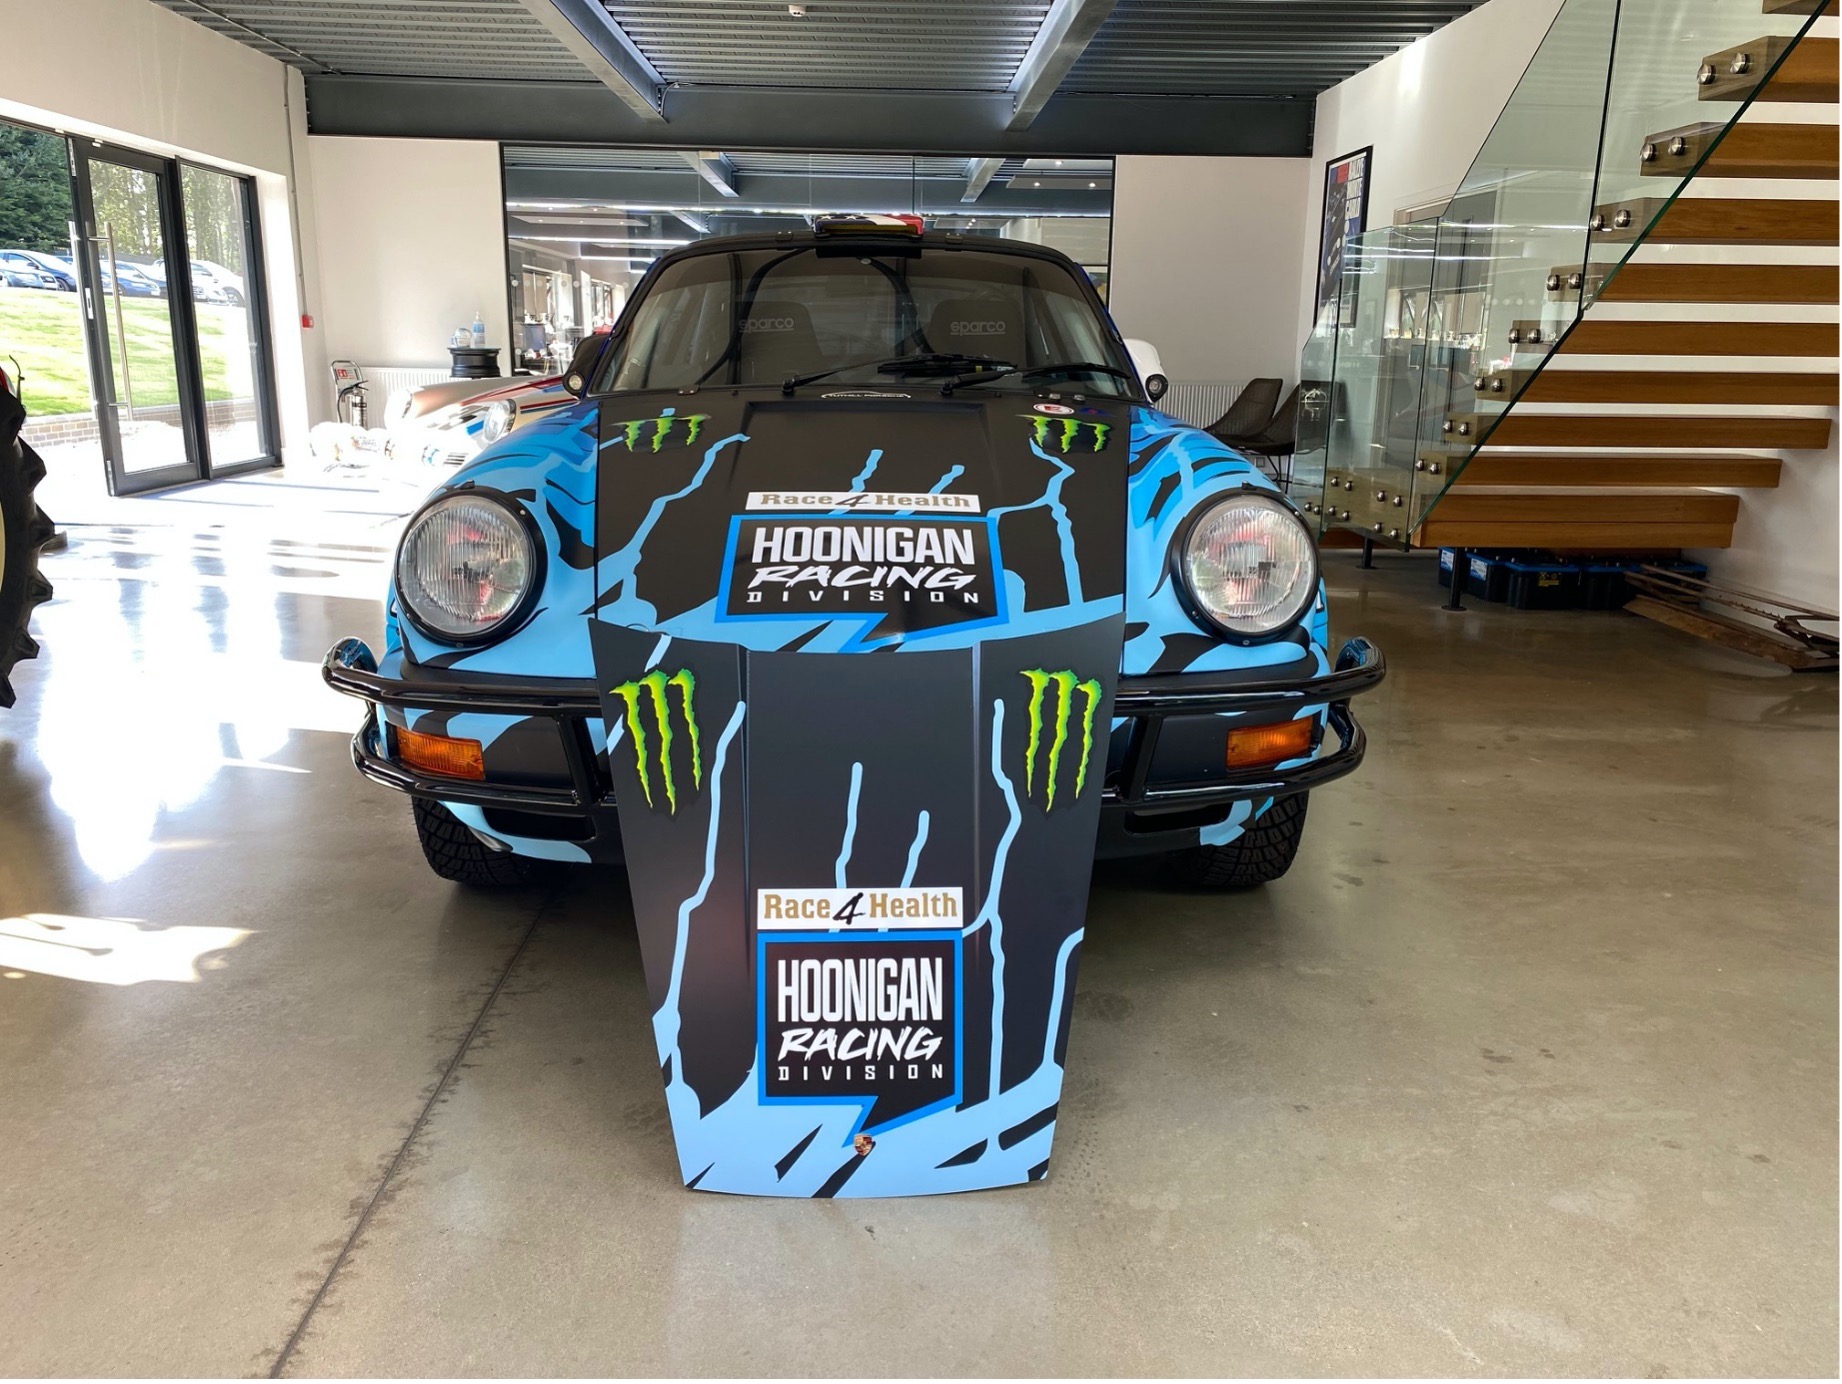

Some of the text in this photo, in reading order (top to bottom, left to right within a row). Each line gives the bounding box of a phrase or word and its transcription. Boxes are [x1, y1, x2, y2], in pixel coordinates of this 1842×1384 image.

[738, 317, 794, 333] sparco
[950, 321, 1006, 336] sparco
[760, 493, 970, 508] Race 4 Health
[752, 526, 975, 565] HOONIGAN
[748, 565, 976, 590] RACING
[747, 591, 978, 604] DIVISION
[764, 892, 957, 925] Race 4 Health
[778, 957, 943, 1022] HOONIGAN
[778, 1025, 943, 1062] RACING
[778, 1063, 943, 1081] DIVISION
